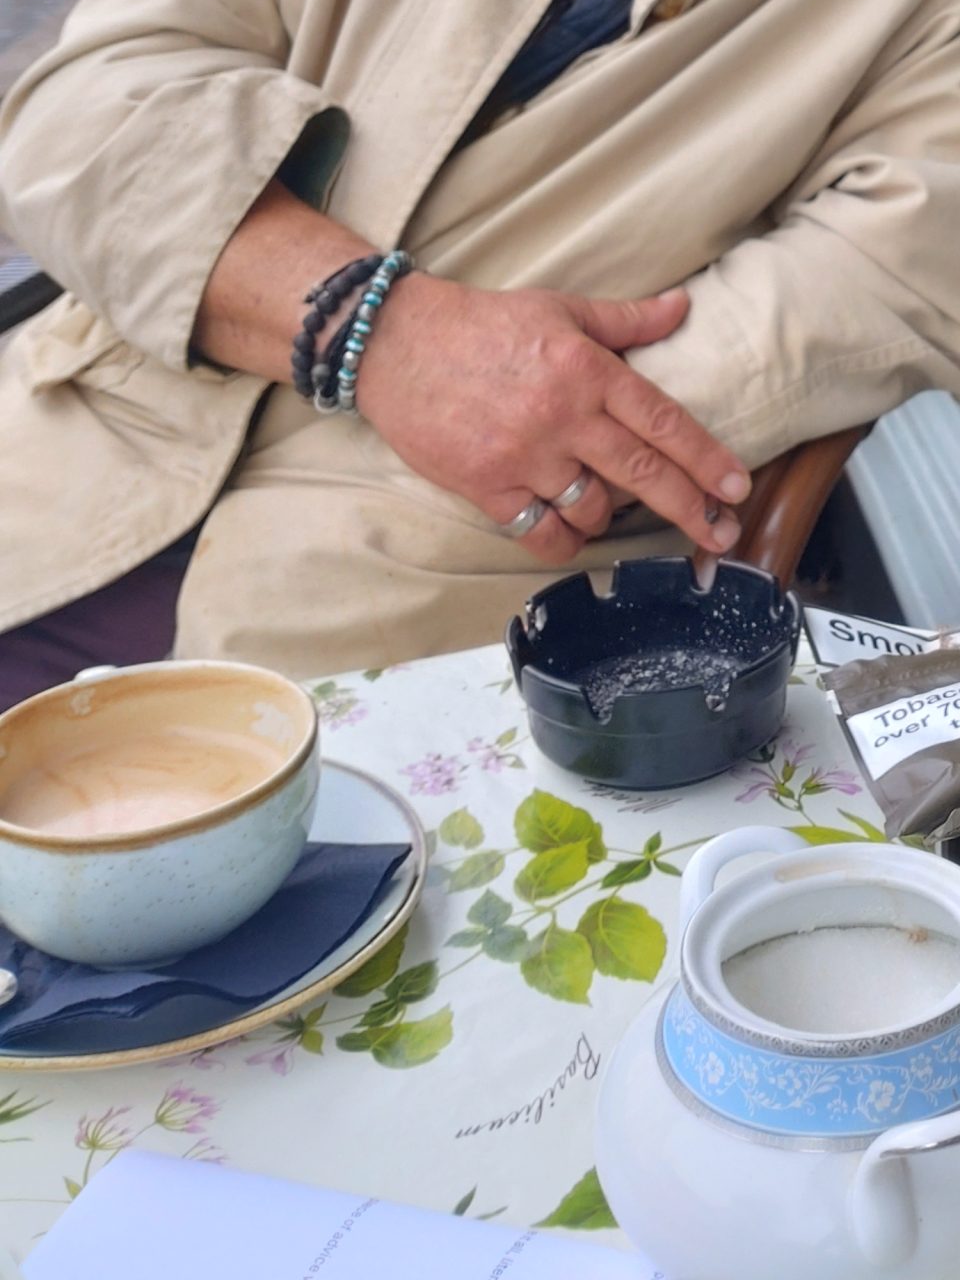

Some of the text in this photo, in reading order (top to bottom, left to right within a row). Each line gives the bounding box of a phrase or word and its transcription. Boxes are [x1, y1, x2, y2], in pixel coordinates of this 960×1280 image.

[873, 713, 931, 748] over
[455, 1031, 601, 1139] Basilicum
[308, 1231, 344, 1273] advice
